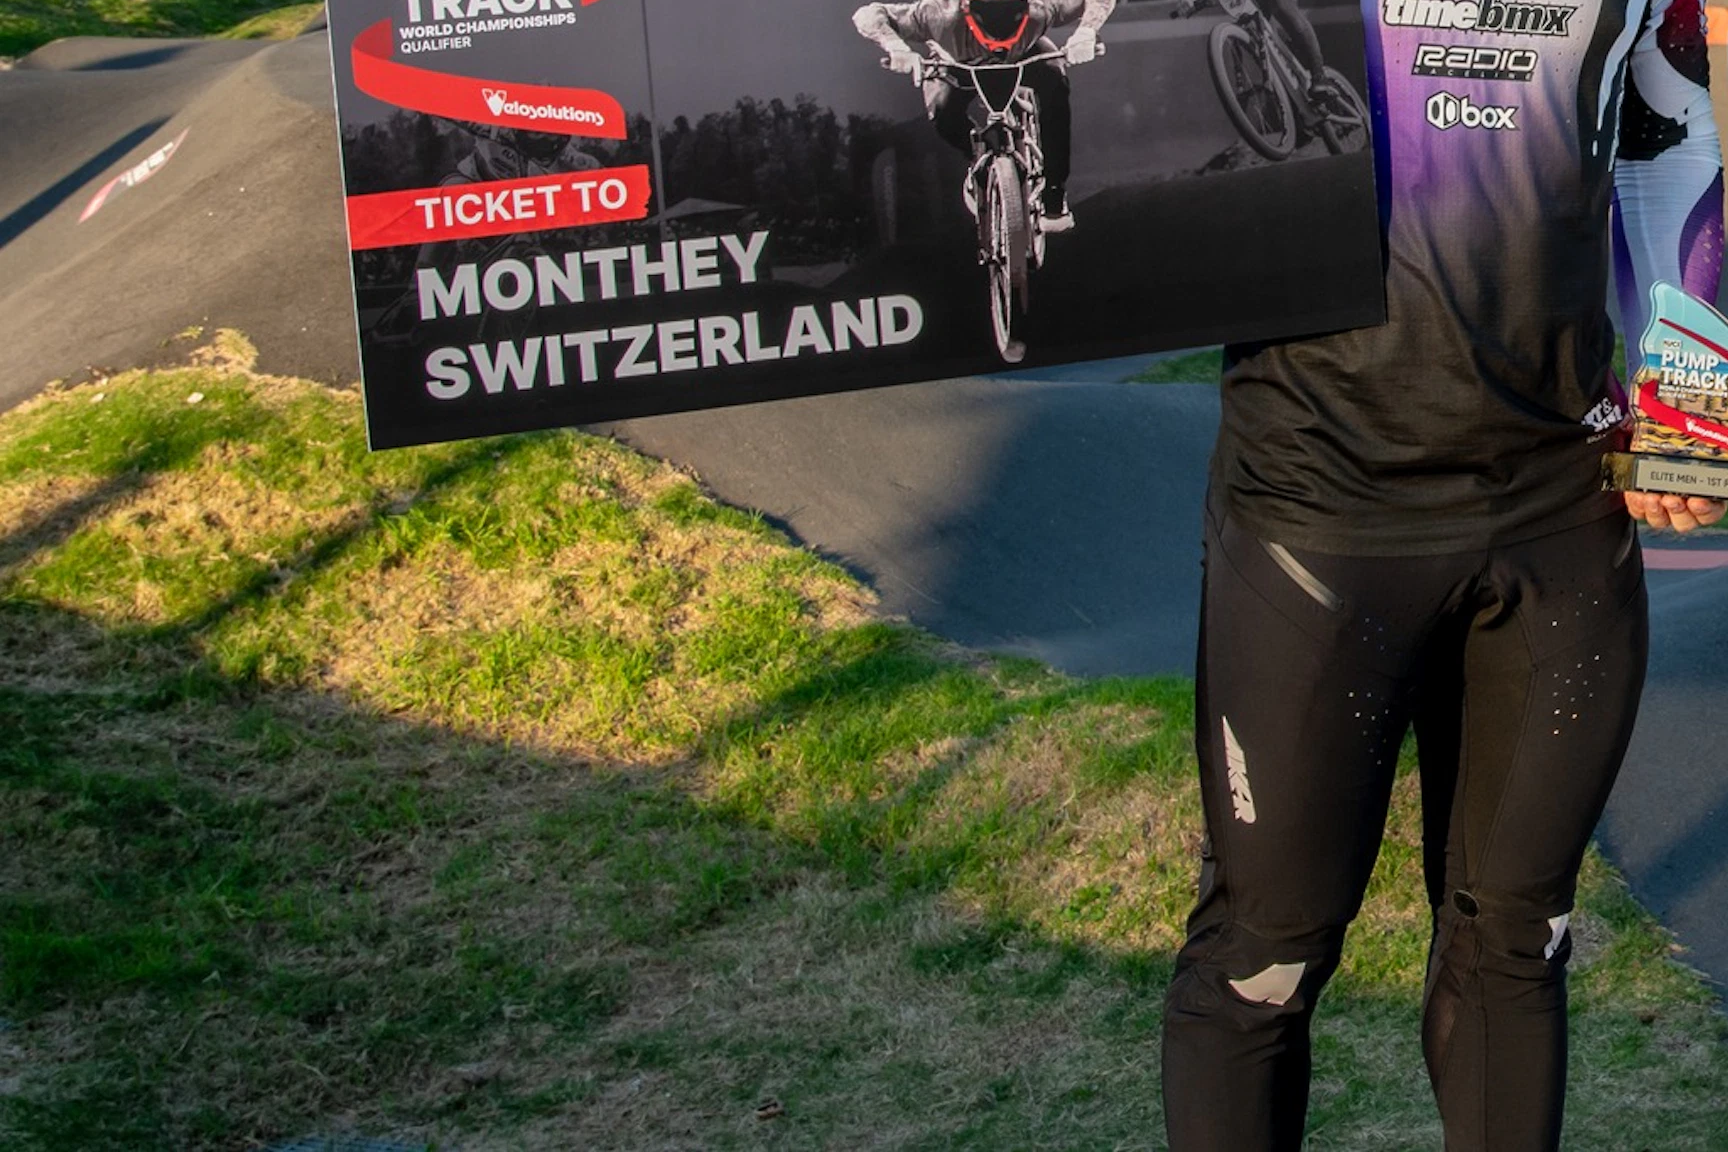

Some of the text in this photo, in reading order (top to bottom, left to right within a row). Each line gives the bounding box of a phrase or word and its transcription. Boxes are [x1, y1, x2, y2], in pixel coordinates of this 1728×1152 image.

[399, 12, 576, 39] WORLD CHAMPIONSHIPS
[400, 36, 472, 54] QUALIFIER
[481, 88, 605, 126] Velosolutions
[1460, 95, 1517, 129] box
[415, 177, 628, 230] TICKET TO
[417, 230, 769, 320] MONTHEY
[425, 294, 924, 400] SWITZERLAND
[1661, 349, 1720, 371] PUMP
[1650, 471, 1675, 482] ELITE
[1676, 474, 1697, 484] MEN
[1707, 476, 1723, 487] 1ST
